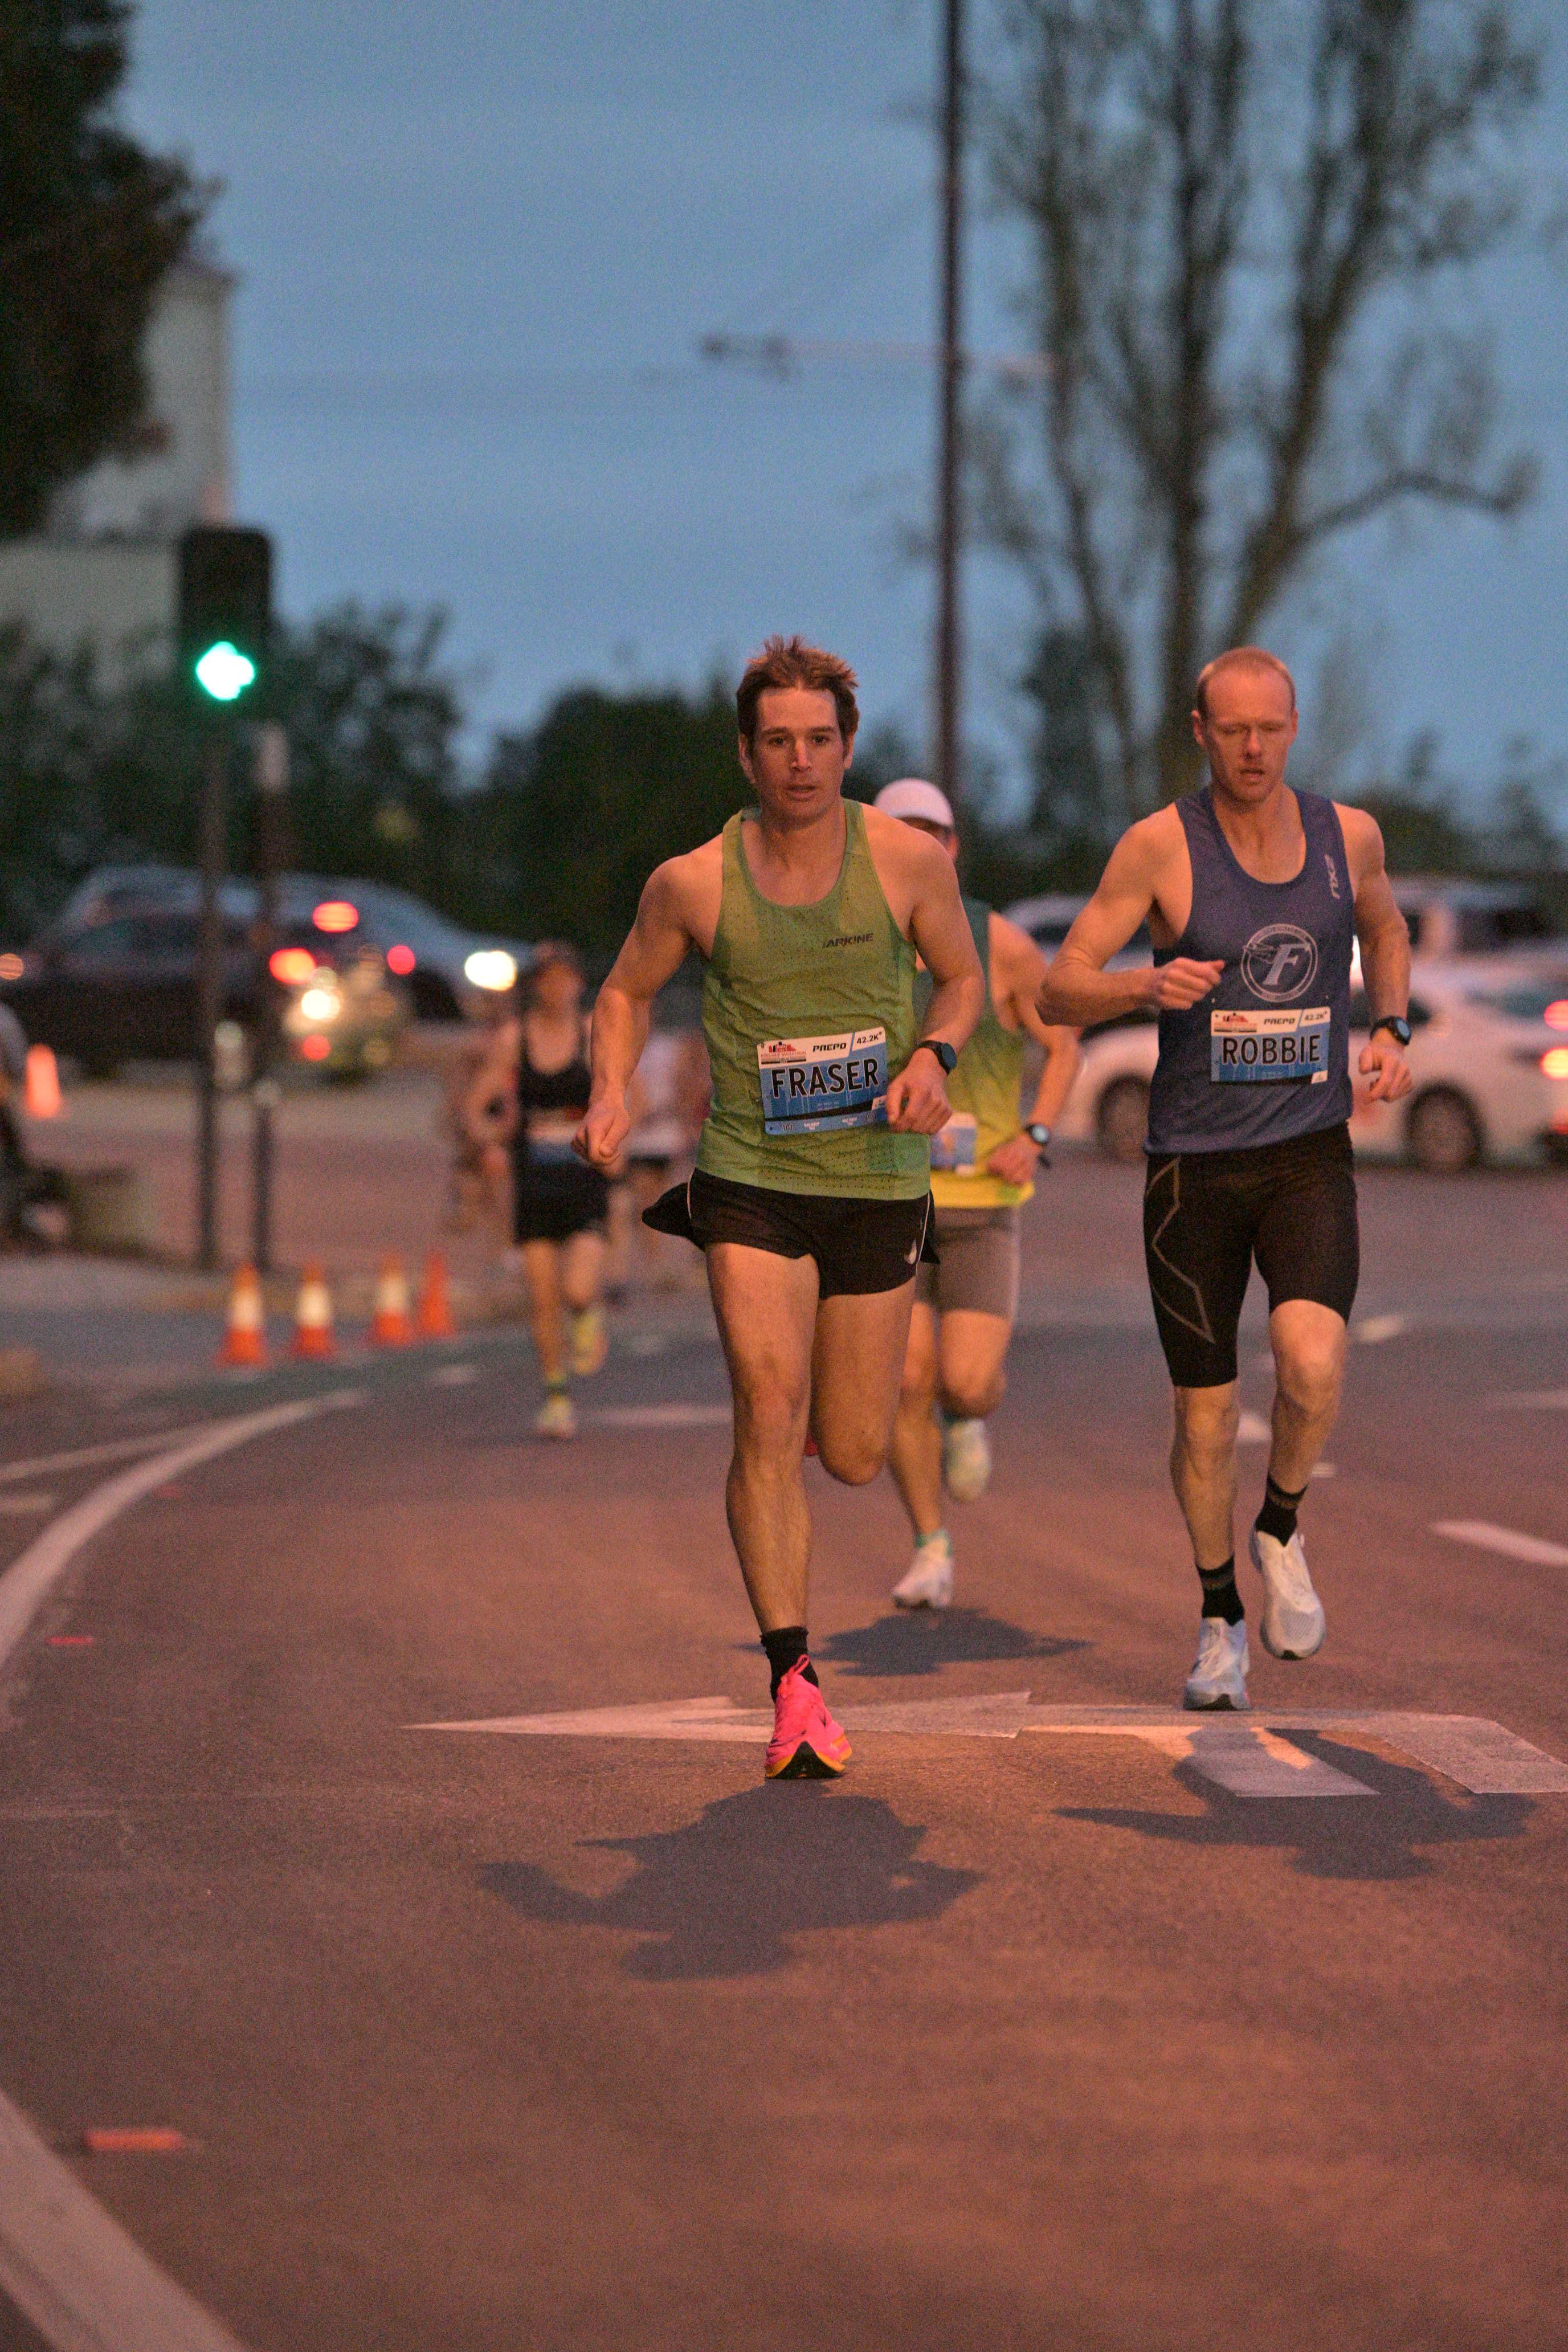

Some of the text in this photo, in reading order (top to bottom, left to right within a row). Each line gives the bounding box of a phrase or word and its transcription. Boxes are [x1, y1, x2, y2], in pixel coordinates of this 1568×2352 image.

[856, 1034, 879, 1044] 42.2K
[1222, 1034, 1321, 1065] ROBBIE
[771, 1058, 879, 1099] FRASER
